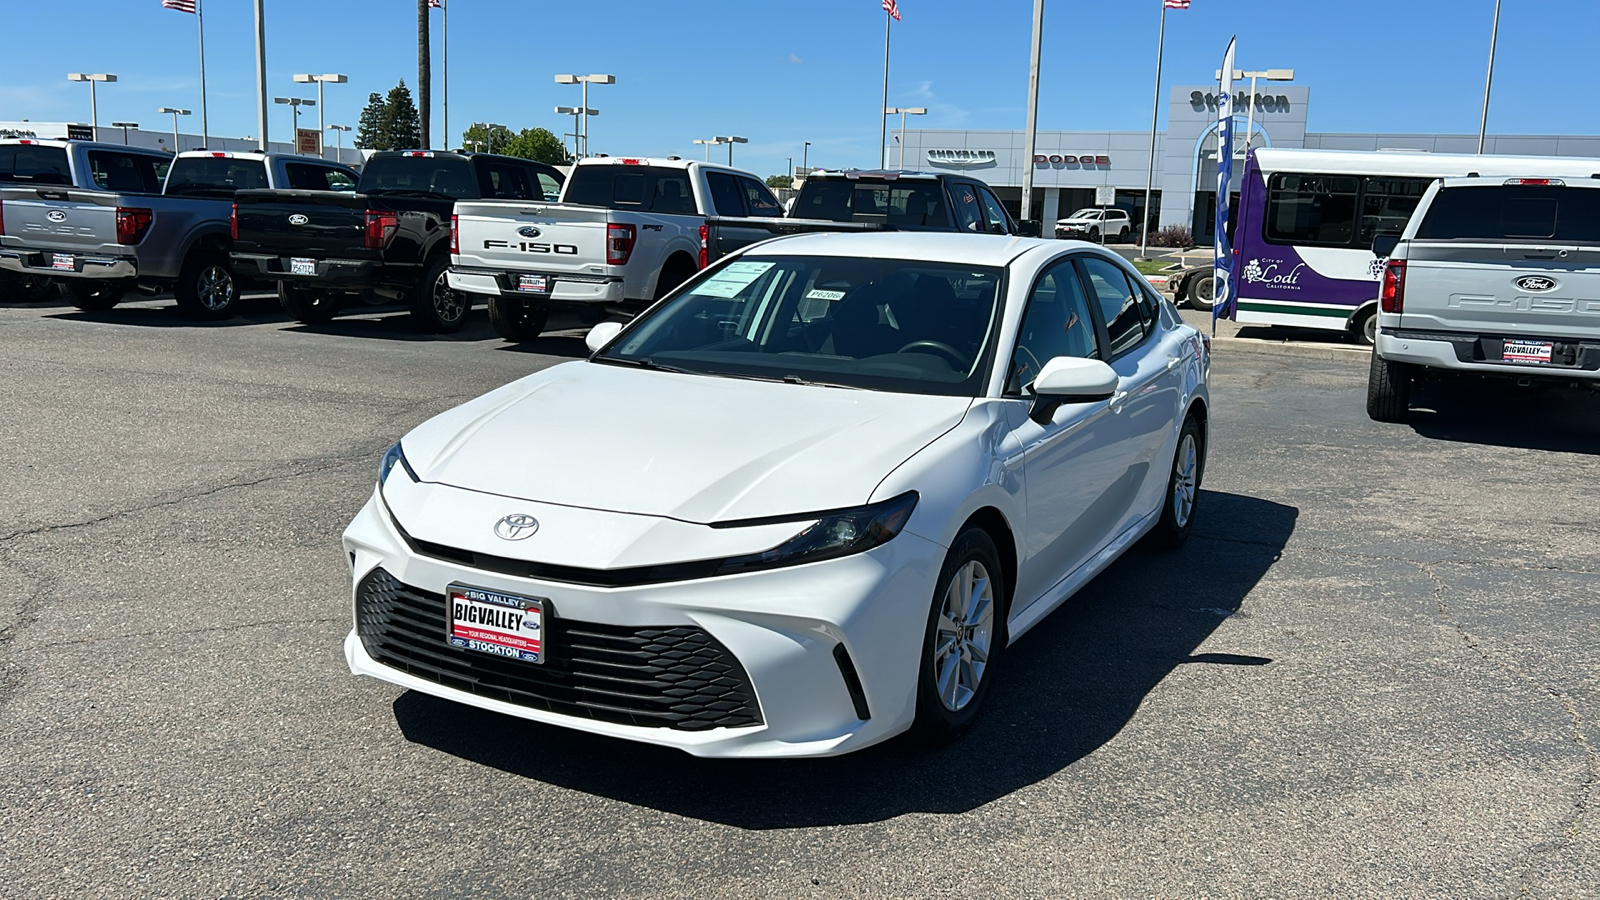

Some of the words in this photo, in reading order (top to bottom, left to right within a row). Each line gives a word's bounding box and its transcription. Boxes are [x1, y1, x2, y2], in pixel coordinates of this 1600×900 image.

[928, 150, 995, 158] CHRYSLER
[1034, 154, 1109, 164] DODGE
[483, 239, 578, 255] F-150
[1253, 263, 1305, 285] Lodi
[1521, 277, 1549, 290] Ford
[1504, 345, 1541, 355] BIGVALLEY
[470, 591, 486, 600] BIG
[487, 595, 519, 607] VALLEY
[455, 603, 523, 632] BIGVALLEY
[480, 632, 498, 641] REGIONAL
[498, 635, 527, 647] HEADQUARTERS
[469, 640, 519, 658] STOCKTON
